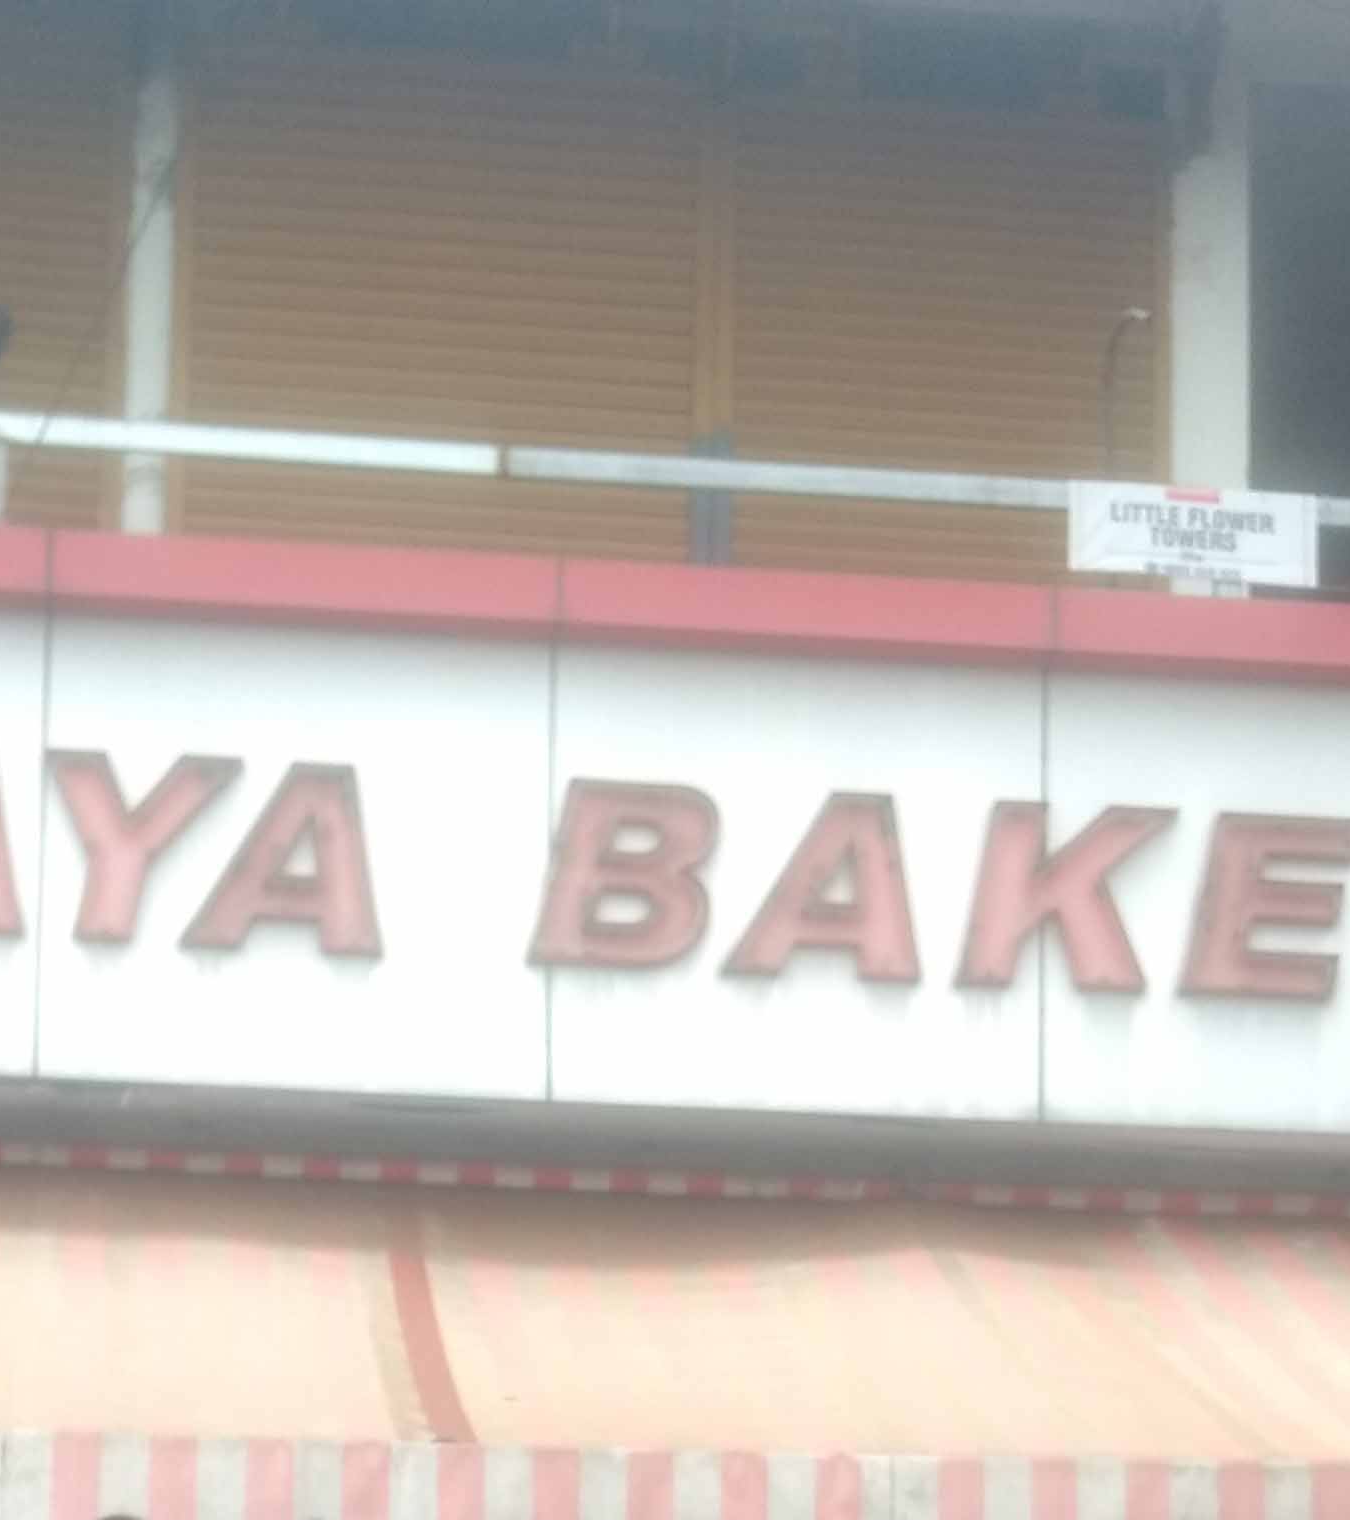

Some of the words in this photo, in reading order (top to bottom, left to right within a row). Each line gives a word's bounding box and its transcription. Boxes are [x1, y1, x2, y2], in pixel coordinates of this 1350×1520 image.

[1109, 502, 1179, 528] LITTLE
[1187, 506, 1276, 535] FLOWER
[1150, 527, 1237, 553] TOWERS
